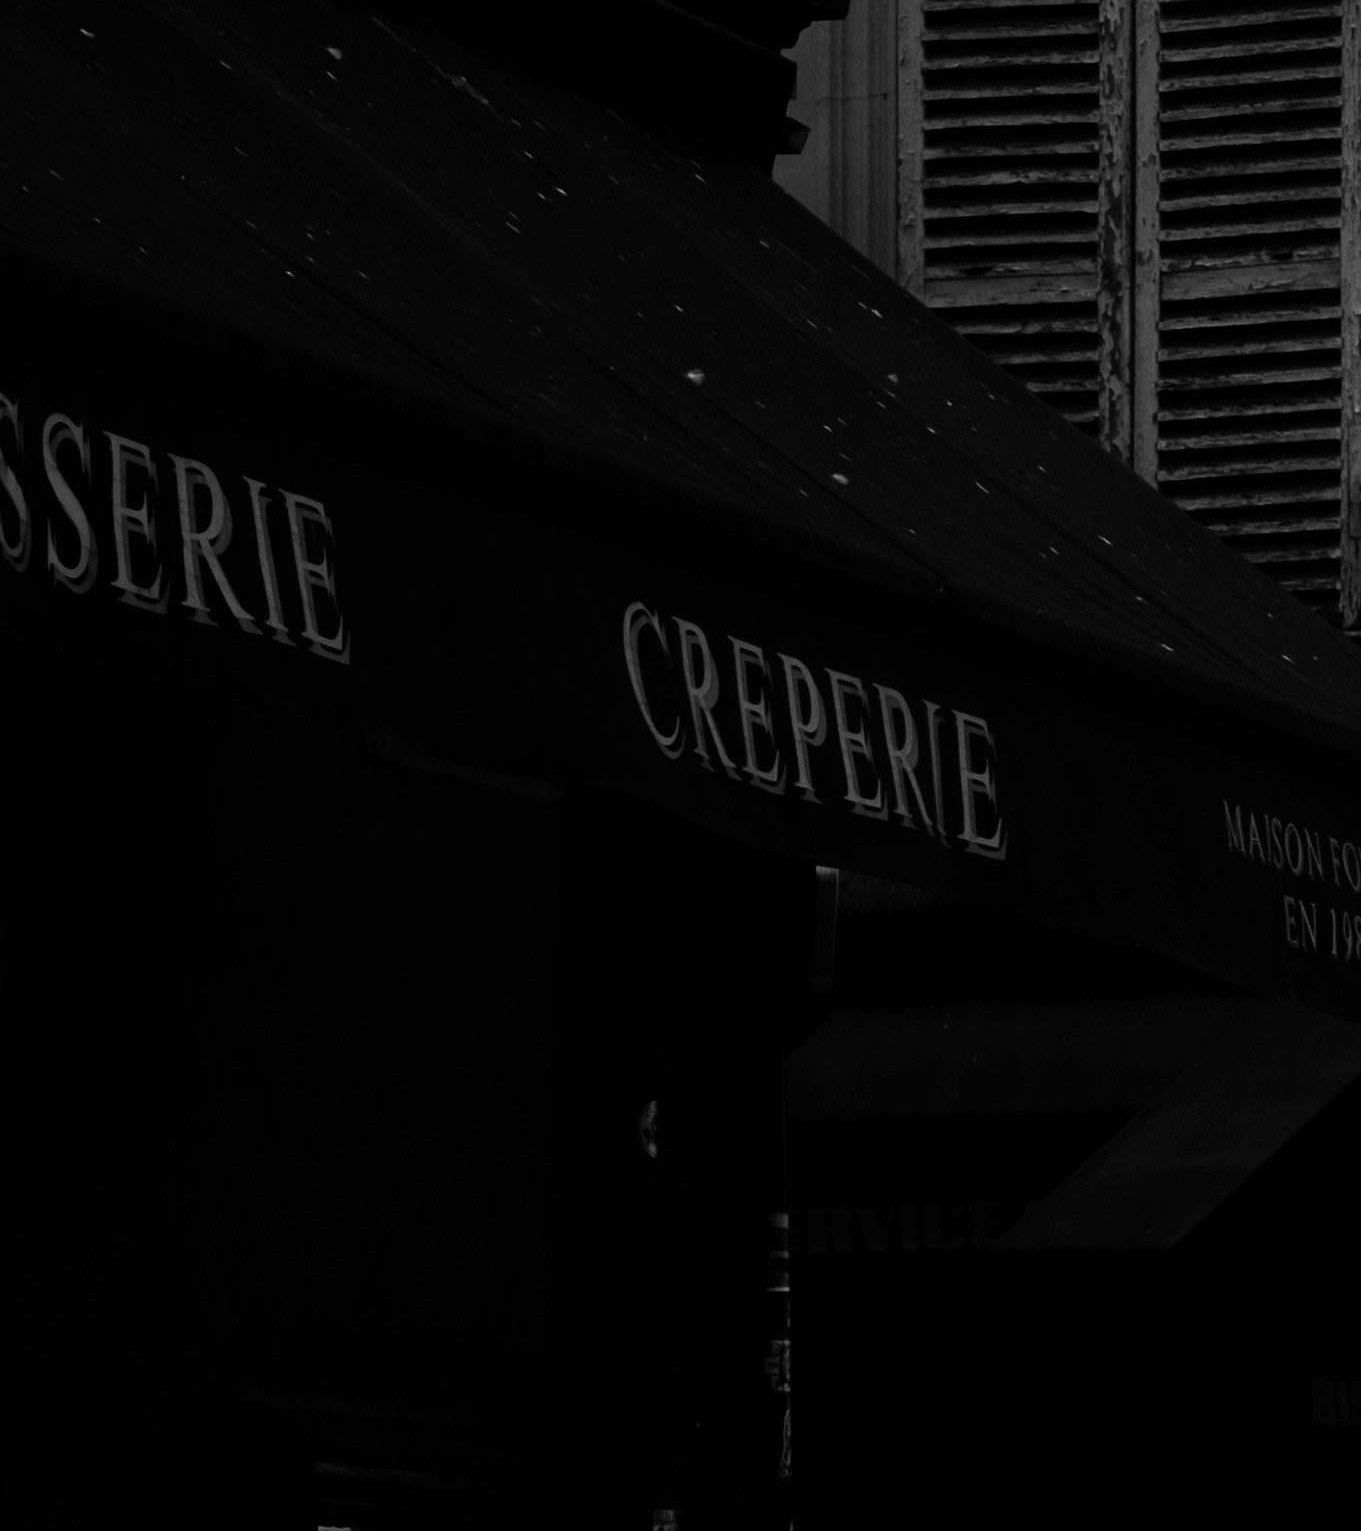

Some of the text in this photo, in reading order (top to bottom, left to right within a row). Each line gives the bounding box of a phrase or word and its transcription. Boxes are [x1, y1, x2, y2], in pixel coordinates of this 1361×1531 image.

[622, 600, 1008, 861] CREPERIE
[1221, 798, 1324, 881] MAISON
[1283, 894, 1318, 954] EN
